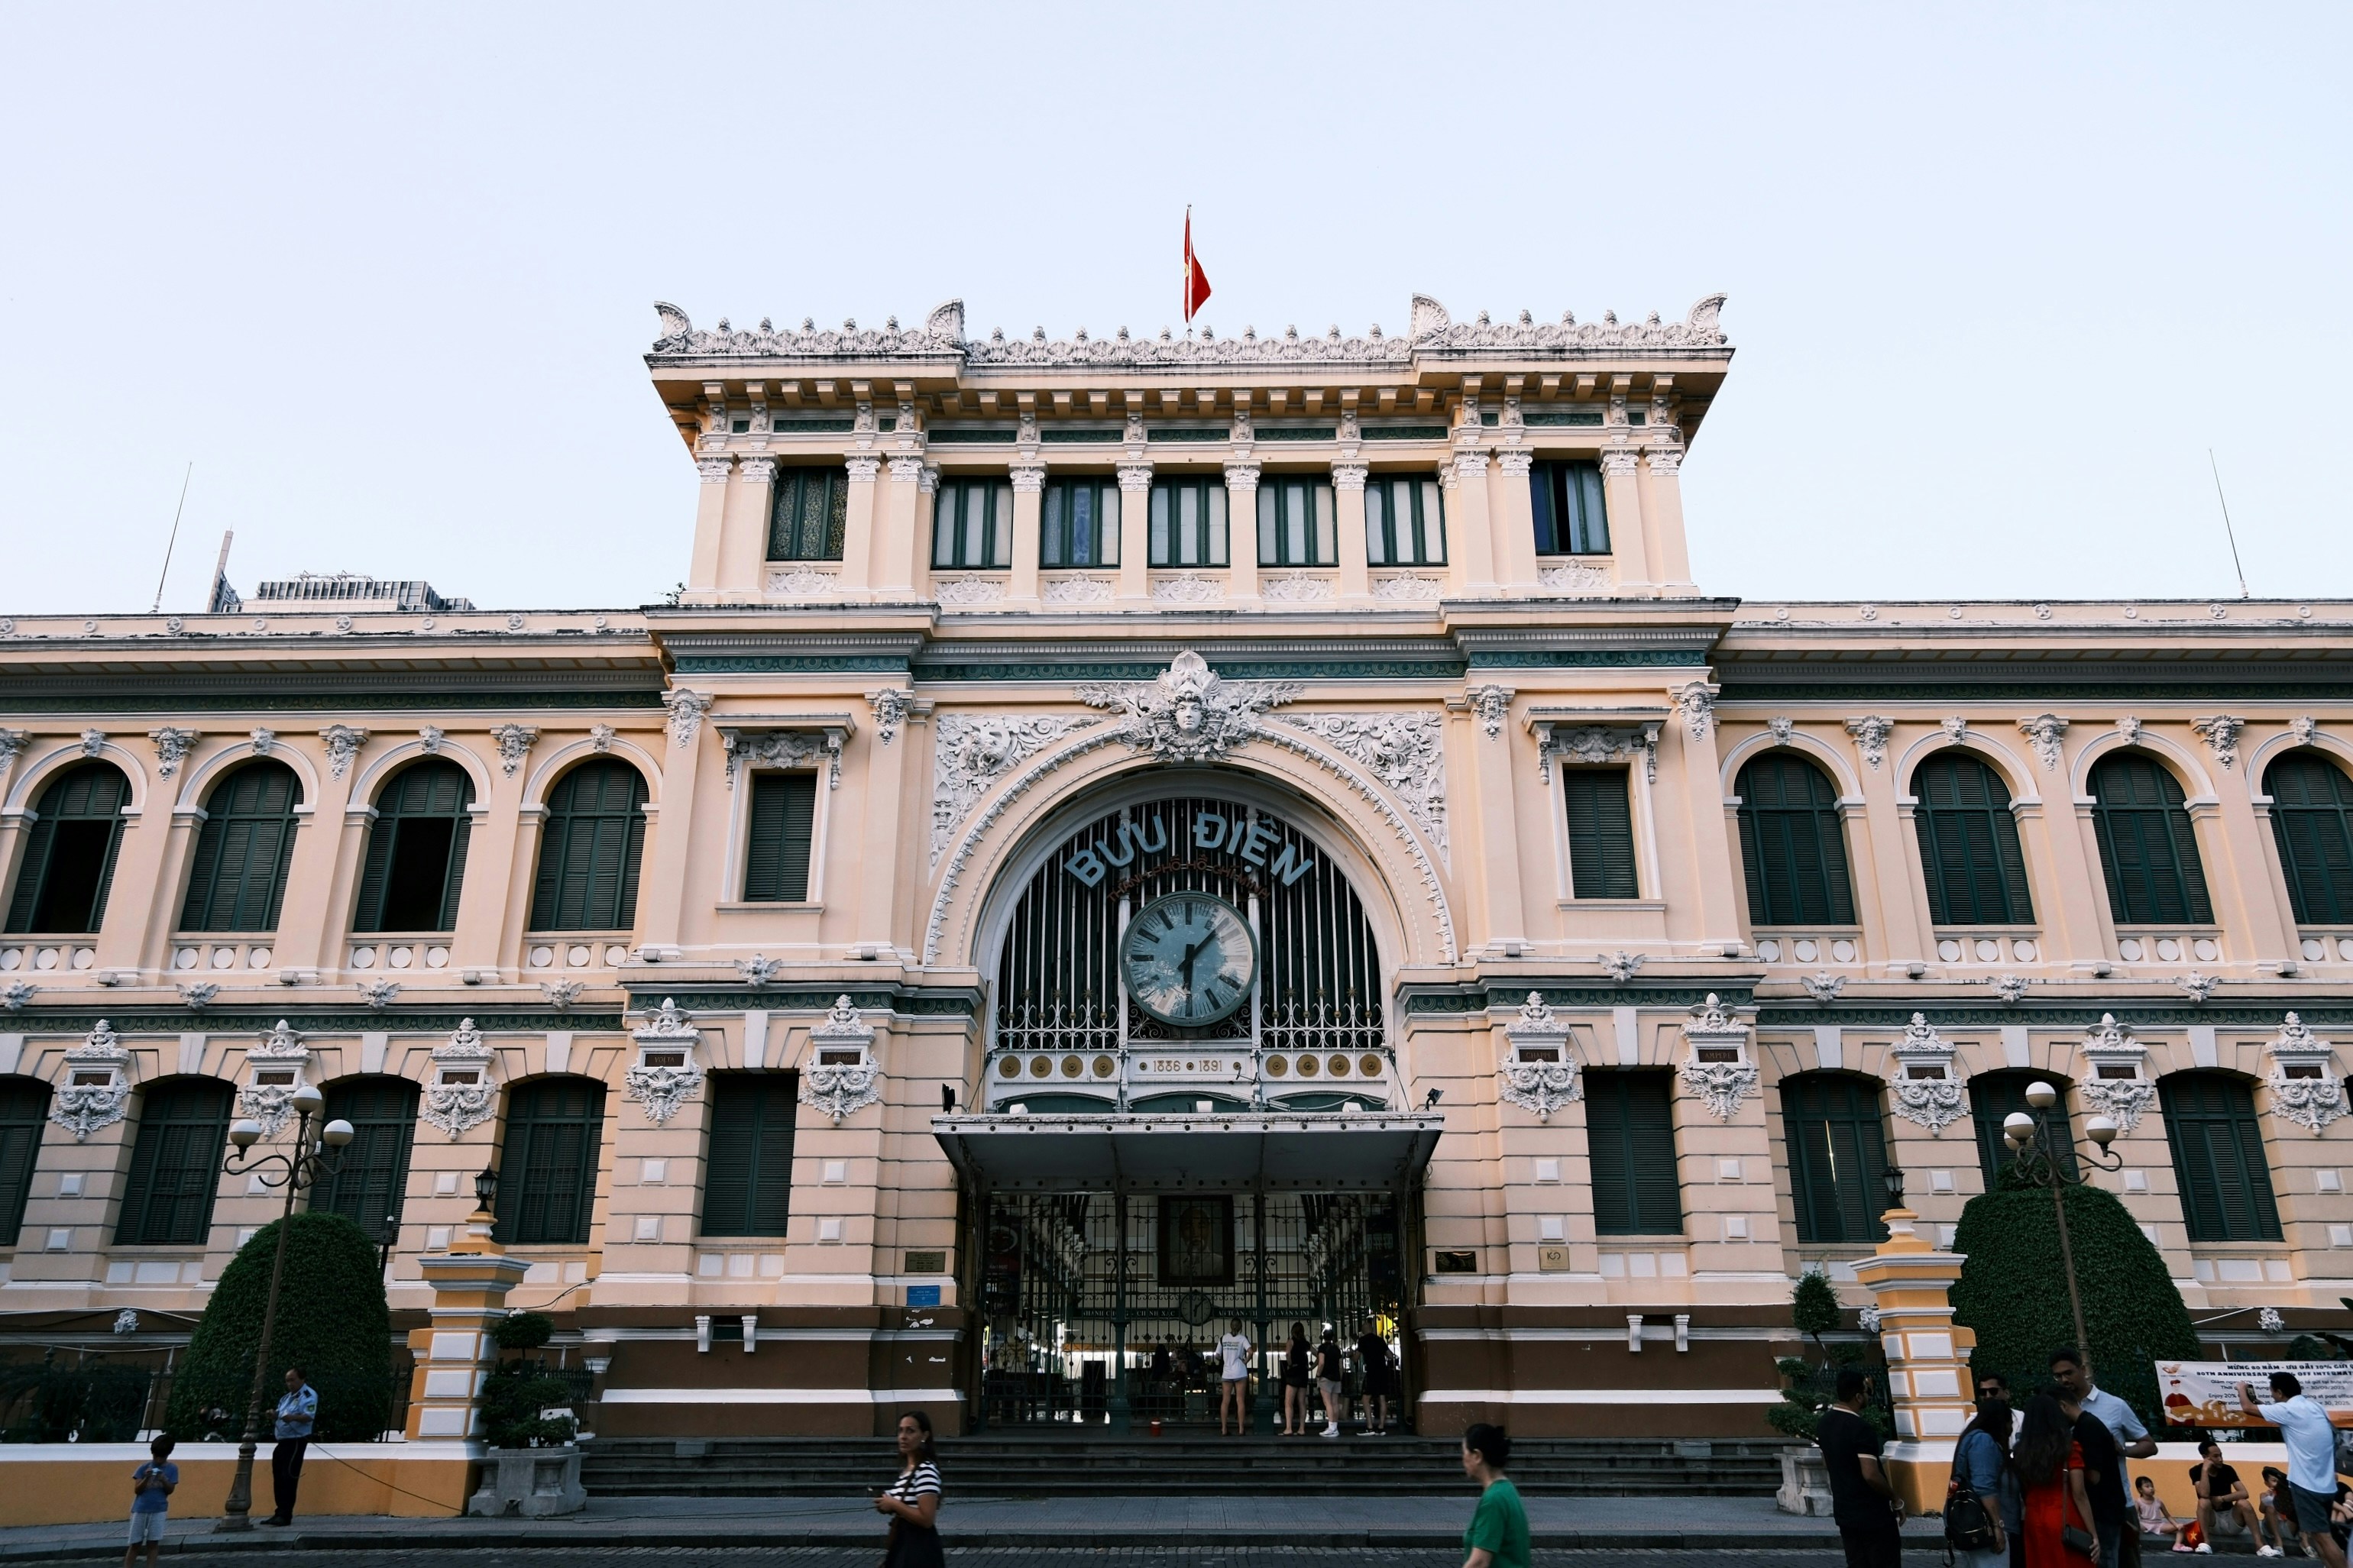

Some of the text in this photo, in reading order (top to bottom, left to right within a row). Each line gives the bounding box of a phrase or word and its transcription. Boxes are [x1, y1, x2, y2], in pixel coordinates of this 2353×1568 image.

[1063, 812, 1315, 888] BƯU ĐIỆN
[1106, 871, 1150, 903] THÀNH
[1151, 854, 1181, 877] PHỐ
[1186, 854, 1208, 871] HỒ
[1238, 871, 1271, 900] MINH
[1153, 1059, 1222, 1072] 1886 1891
